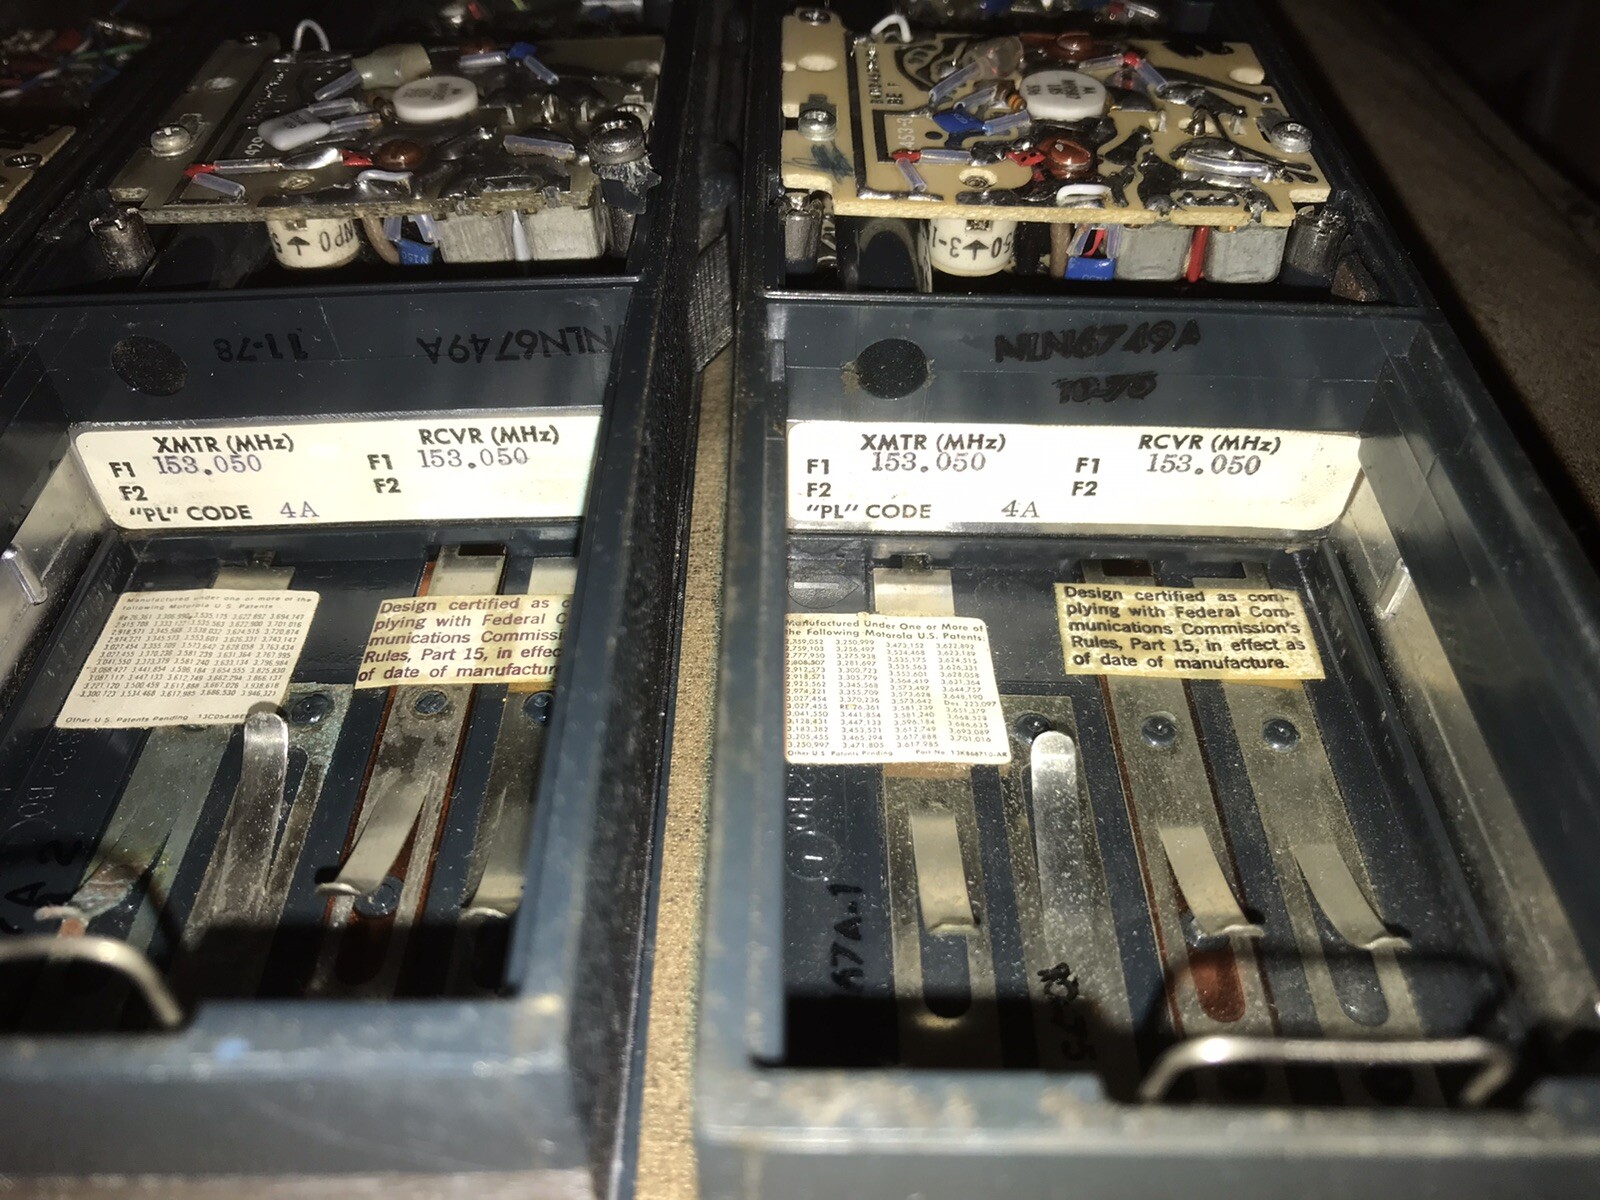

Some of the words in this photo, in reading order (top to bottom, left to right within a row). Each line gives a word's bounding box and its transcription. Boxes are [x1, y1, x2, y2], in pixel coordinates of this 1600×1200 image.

[213, 331, 309, 363] 11-78
[152, 436, 219, 454] XMTR
[226, 433, 294, 453] (MHz)
[419, 426, 481, 446] RCVR
[490, 425, 560, 446] (MHz)
[860, 433, 927, 451] XMTR
[935, 432, 1007, 452] (MHz)
[1138, 433, 1203, 451] RCVR
[1210, 433, 1281, 455] (MHz)
[109, 461, 136, 478] F1
[152, 454, 263, 477] 153.050
[367, 454, 393, 471] F1
[419, 446, 529, 470] 153.050
[806, 459, 830, 475] F1
[871, 451, 987, 475] 153.050
[1075, 457, 1100, 474] F1
[1146, 453, 1262, 476] 153.050
[119, 485, 148, 501] F2
[374, 477, 401, 494] F2
[806, 482, 831, 498] F2
[1071, 481, 1098, 497] F2
[186, 504, 252, 521] CODE
[279, 502, 320, 519] 4A
[865, 503, 932, 520] CODE
[1000, 501, 1041, 519] 4A
[1064, 585, 1123, 602] Design
[1134, 590, 1205, 602] certified
[1217, 592, 1236, 602] as
[380, 601, 437, 615] Design
[448, 597, 520, 611] certified
[530, 599, 550, 609] as
[1066, 602, 1120, 618] plying
[1128, 604, 1165, 618] with
[1175, 606, 1240, 618] Federal
[1250, 606, 1295, 618] Com-
[373, 616, 427, 633] plying
[436, 614, 471, 628] with
[482, 612, 546, 627] Federal
[785, 619, 859, 627] Manufactured
[864, 620, 896, 629] Under
[942, 623, 968, 631] More
[1068, 620, 1173, 635] munications
[1182, 622, 1300, 636] Commission's
[369, 632, 471, 647] munications
[481, 629, 563, 643] Commissi
[785, 628, 801, 636] the
[807, 628, 859, 638] Following
[864, 629, 913, 639] Motorola
[917, 632, 939, 640] U.S.
[943, 632, 986, 642] Patents:
[1071, 635, 1123, 650] Rules,
[1130, 637, 1165, 650] Part
[1174, 640, 1200, 654] 15,
[1206, 639, 1222, 652] in
[1231, 640, 1280, 651] effect
[1286, 641, 1306, 651] as
[363, 650, 412, 664] Rules,
[421, 648, 456, 661] Part
[463, 647, 489, 661] 15,
[497, 646, 512, 659] in
[1073, 653, 1091, 666] of
[1100, 654, 1138, 667] date
[1147, 655, 1163, 668] of
[1174, 655, 1289, 670] manufacture.
[358, 668, 376, 682] of
[383, 666, 420, 679] date
[429, 665, 448, 678] of
[456, 663, 557, 677] manufactur
[152, 715, 188, 723] Pending
